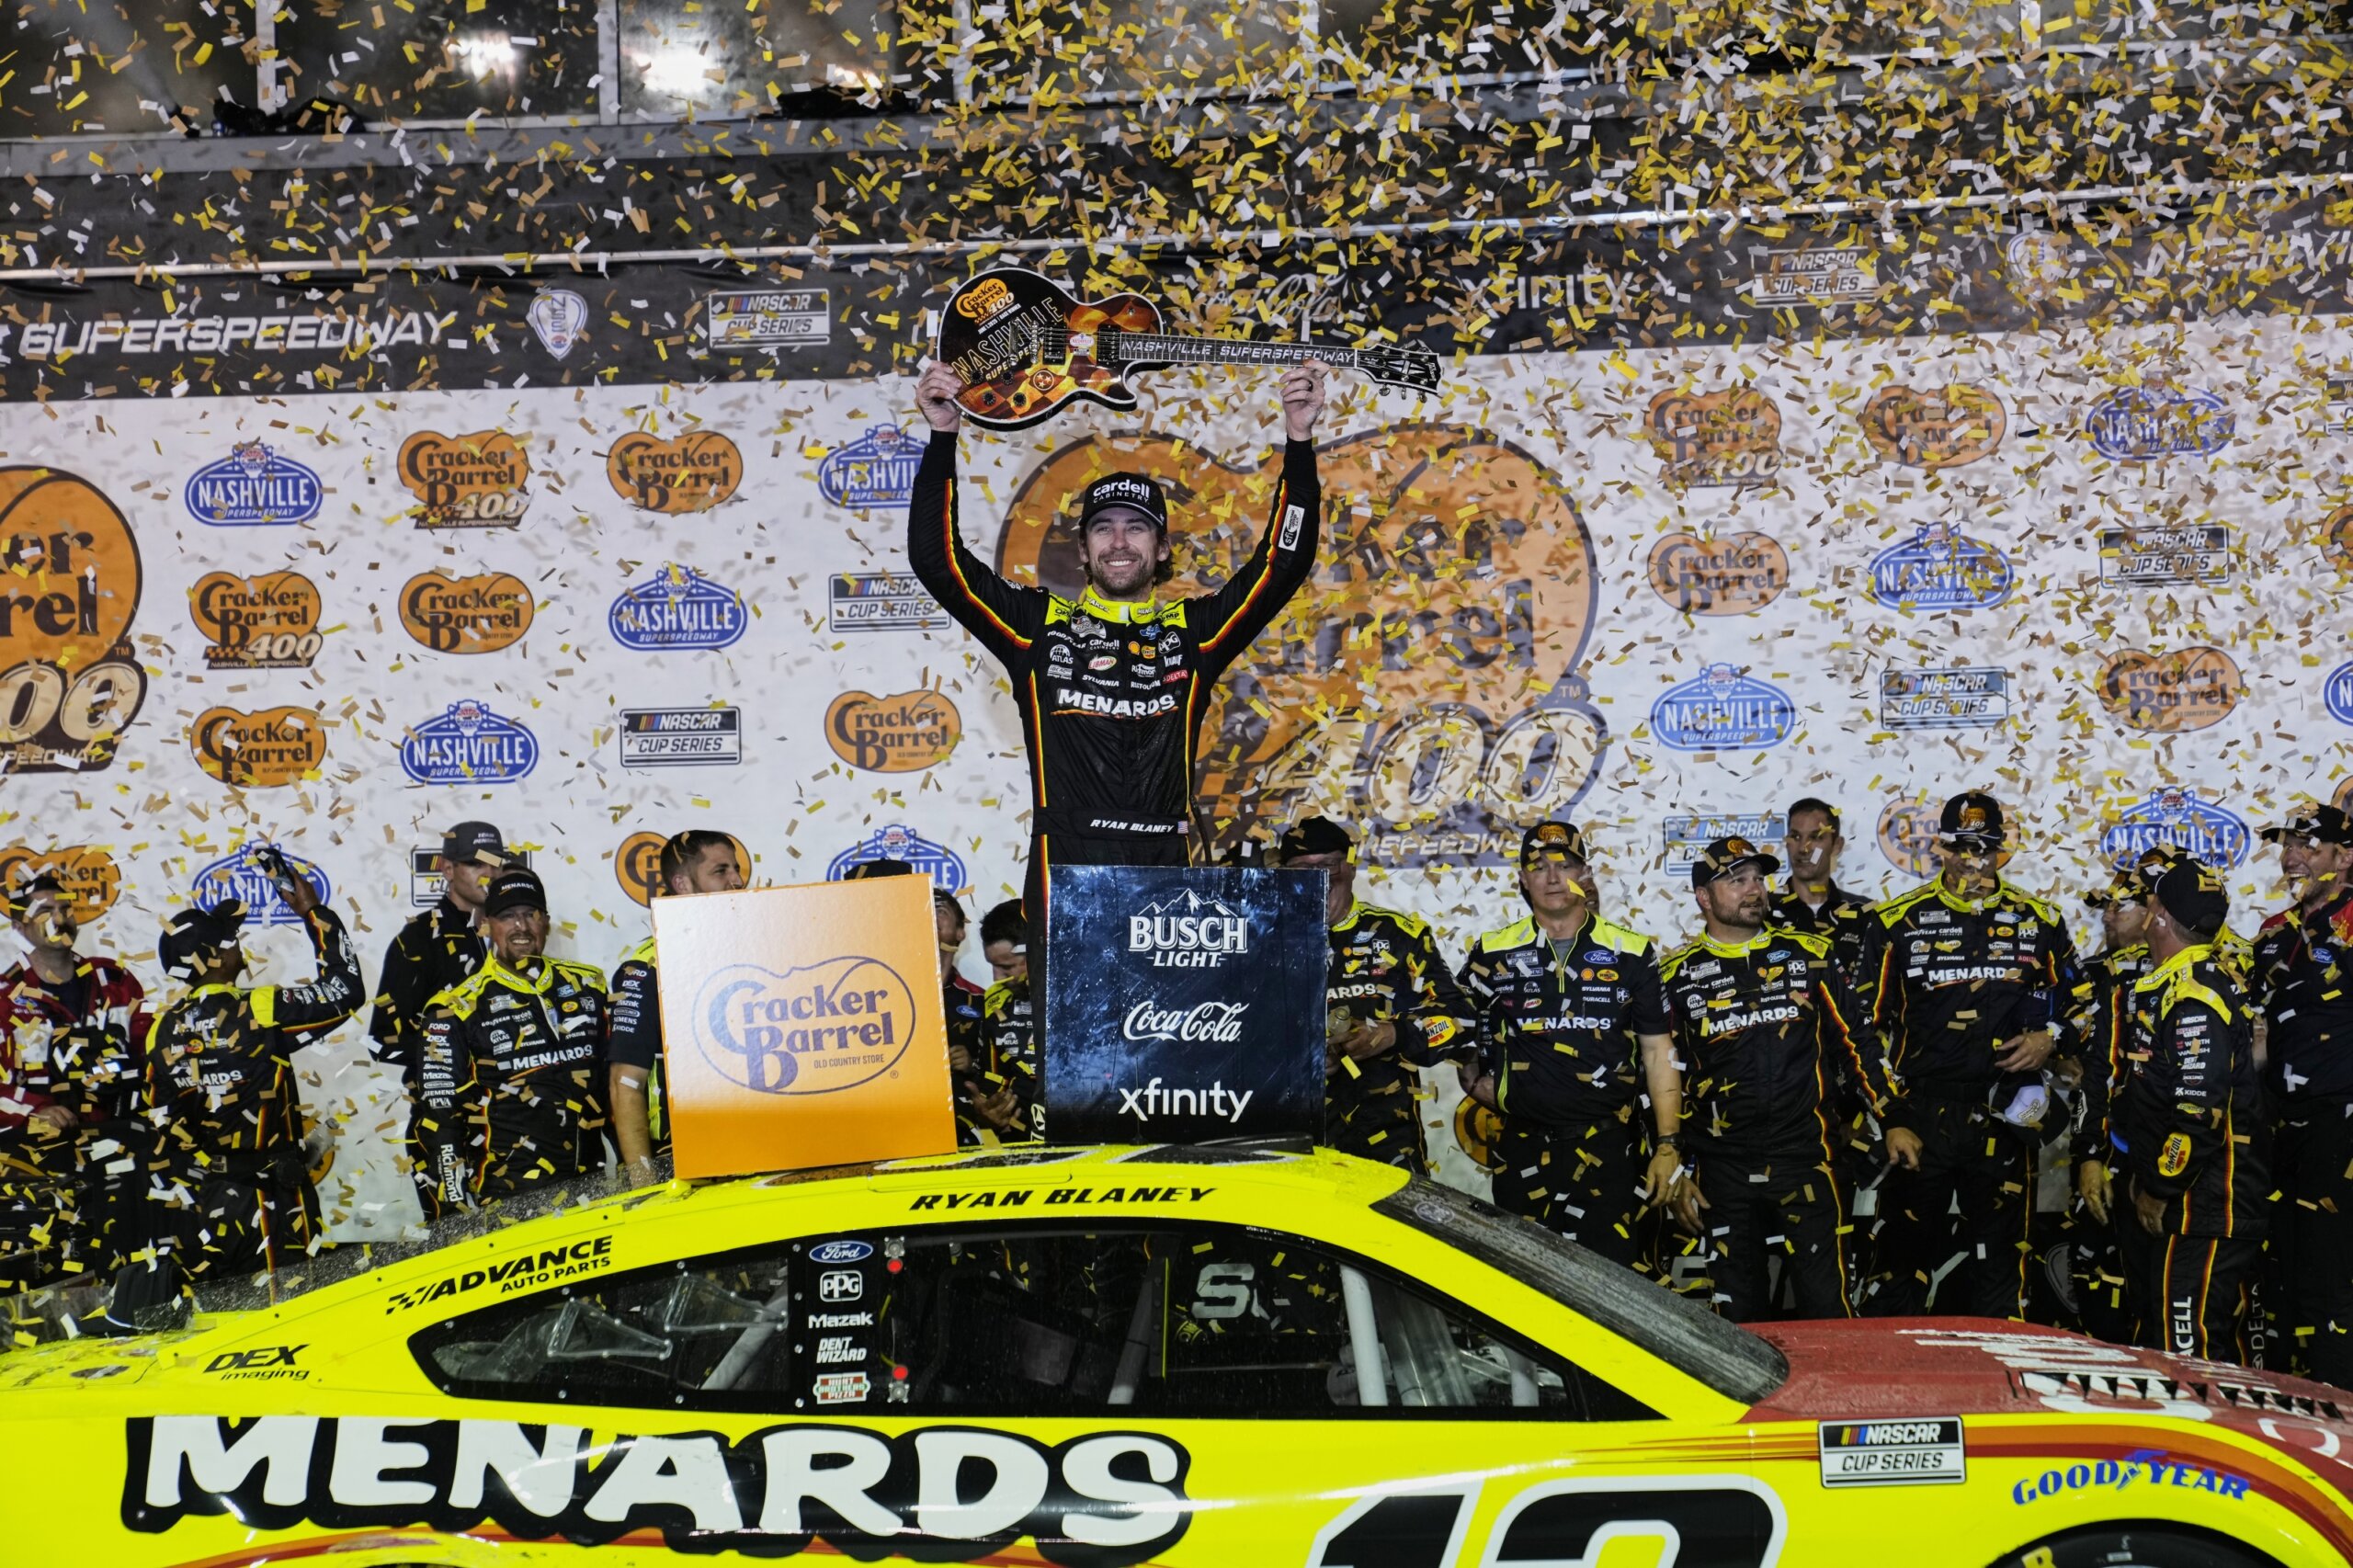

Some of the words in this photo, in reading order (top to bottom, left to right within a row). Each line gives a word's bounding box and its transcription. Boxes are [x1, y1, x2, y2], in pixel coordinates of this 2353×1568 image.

[18, 312, 458, 356] SUPERSPEEDWAY
[1121, 340, 1212, 356] NASHVILLE
[1220, 346, 1355, 364] SUPERSPEEDWAY
[406, 440, 509, 483] Cracker
[198, 477, 311, 508] NASHVILLE
[426, 464, 516, 507] Barrel
[1093, 479, 1151, 497] cardell
[1094, 492, 1149, 504] CABINETRY
[1656, 542, 1773, 588] Cracker
[868, 578, 922, 596] NASCA
[1678, 567, 1777, 613] Barrel
[199, 580, 306, 625] Cracker
[847, 603, 878, 618] CUP
[621, 604, 734, 632] NASHVILLE
[248, 632, 323, 660] 400
[639, 632, 718, 642] SUPERSPEEDWAY
[114, 647, 130, 656] TM
[1051, 654, 1074, 665] ATLAS
[1088, 658, 1114, 670] LIBMAN
[1082, 674, 1120, 687] SYLVANIA
[1920, 675, 1985, 692] NASCAR
[1560, 686, 1581, 697] TM
[1058, 688, 1176, 717] MENARDS
[1899, 699, 1932, 715] CUP
[658, 713, 722, 730] NASCAR
[834, 700, 945, 745] Cracker
[1665, 699, 1781, 731] NASHVILLE
[639, 738, 668, 753] CUP
[670, 736, 723, 752] SERIES
[1684, 731, 1766, 743] SUPERSPEEDWY
[414, 735, 526, 767] NASHVILLE
[855, 725, 949, 770] Barrel
[1089, 817, 1127, 831] RYAN
[1130, 821, 1175, 835] BLANEY
[1704, 822, 1768, 837] NASCAR
[501, 882, 534, 891] MENARDS
[1128, 915, 1248, 954] BUSCH
[1153, 950, 1219, 968] LIGHT
[1789, 961, 1805, 972] PPG
[1711, 975, 1734, 986] cardell
[1928, 966, 2021, 983] MENARD
[1326, 983, 1376, 1000] ARDS
[427, 1022, 450, 1030] FORD
[708, 980, 888, 1053] Cracker
[1123, 999, 1249, 1042] Coca-Cola
[1709, 1006, 1799, 1035] MENARDS
[512, 1045, 593, 1071] MENARDS
[743, 1011, 895, 1094] Barrel
[813, 1058, 827, 1069] OLD
[828, 1055, 861, 1068] COUNTRY
[862, 1053, 884, 1065] STORE
[1118, 1076, 1254, 1123] xfinity
[908, 1190, 1036, 1212] RYAN
[1042, 1186, 1219, 1206] BLANEY
[438, 1235, 613, 1297] ADVANCE
[500, 1267, 551, 1294] AUTO
[552, 1255, 611, 1283] PARTS
[823, 1274, 859, 1299] PPG
[808, 1311, 874, 1329] Mazak
[818, 1336, 853, 1351] DENT
[202, 1344, 310, 1373] DEX
[816, 1347, 868, 1364] WIZARD
[221, 1368, 310, 1382] imaging
[827, 1391, 856, 1400] PIZZA
[1865, 1425, 1942, 1444] NASCAR
[1841, 1453, 1878, 1471] CUP
[1881, 1451, 1943, 1470] SERIES
[136, 1415, 1187, 1553] MENARDS
[2012, 1449, 2250, 1506] GOODYEAR
